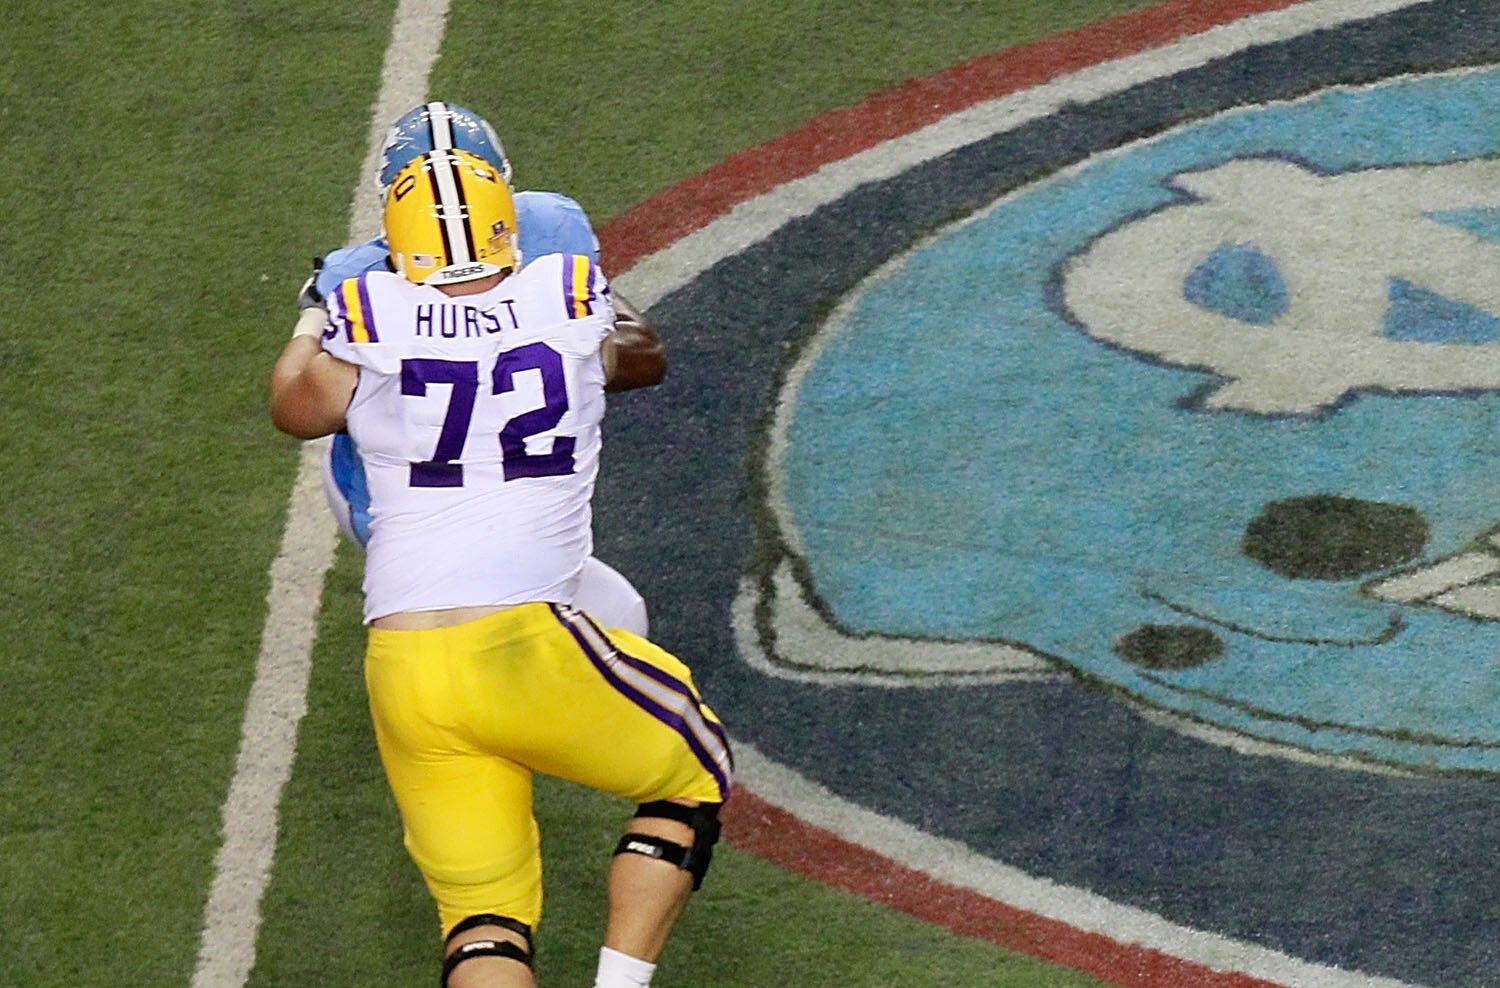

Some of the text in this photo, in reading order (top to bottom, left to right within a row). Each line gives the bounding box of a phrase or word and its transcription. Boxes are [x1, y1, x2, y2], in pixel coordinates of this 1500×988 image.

[441, 264, 484, 279] TIGERS
[416, 299, 518, 338] HURST
[401, 342, 577, 488] 72
